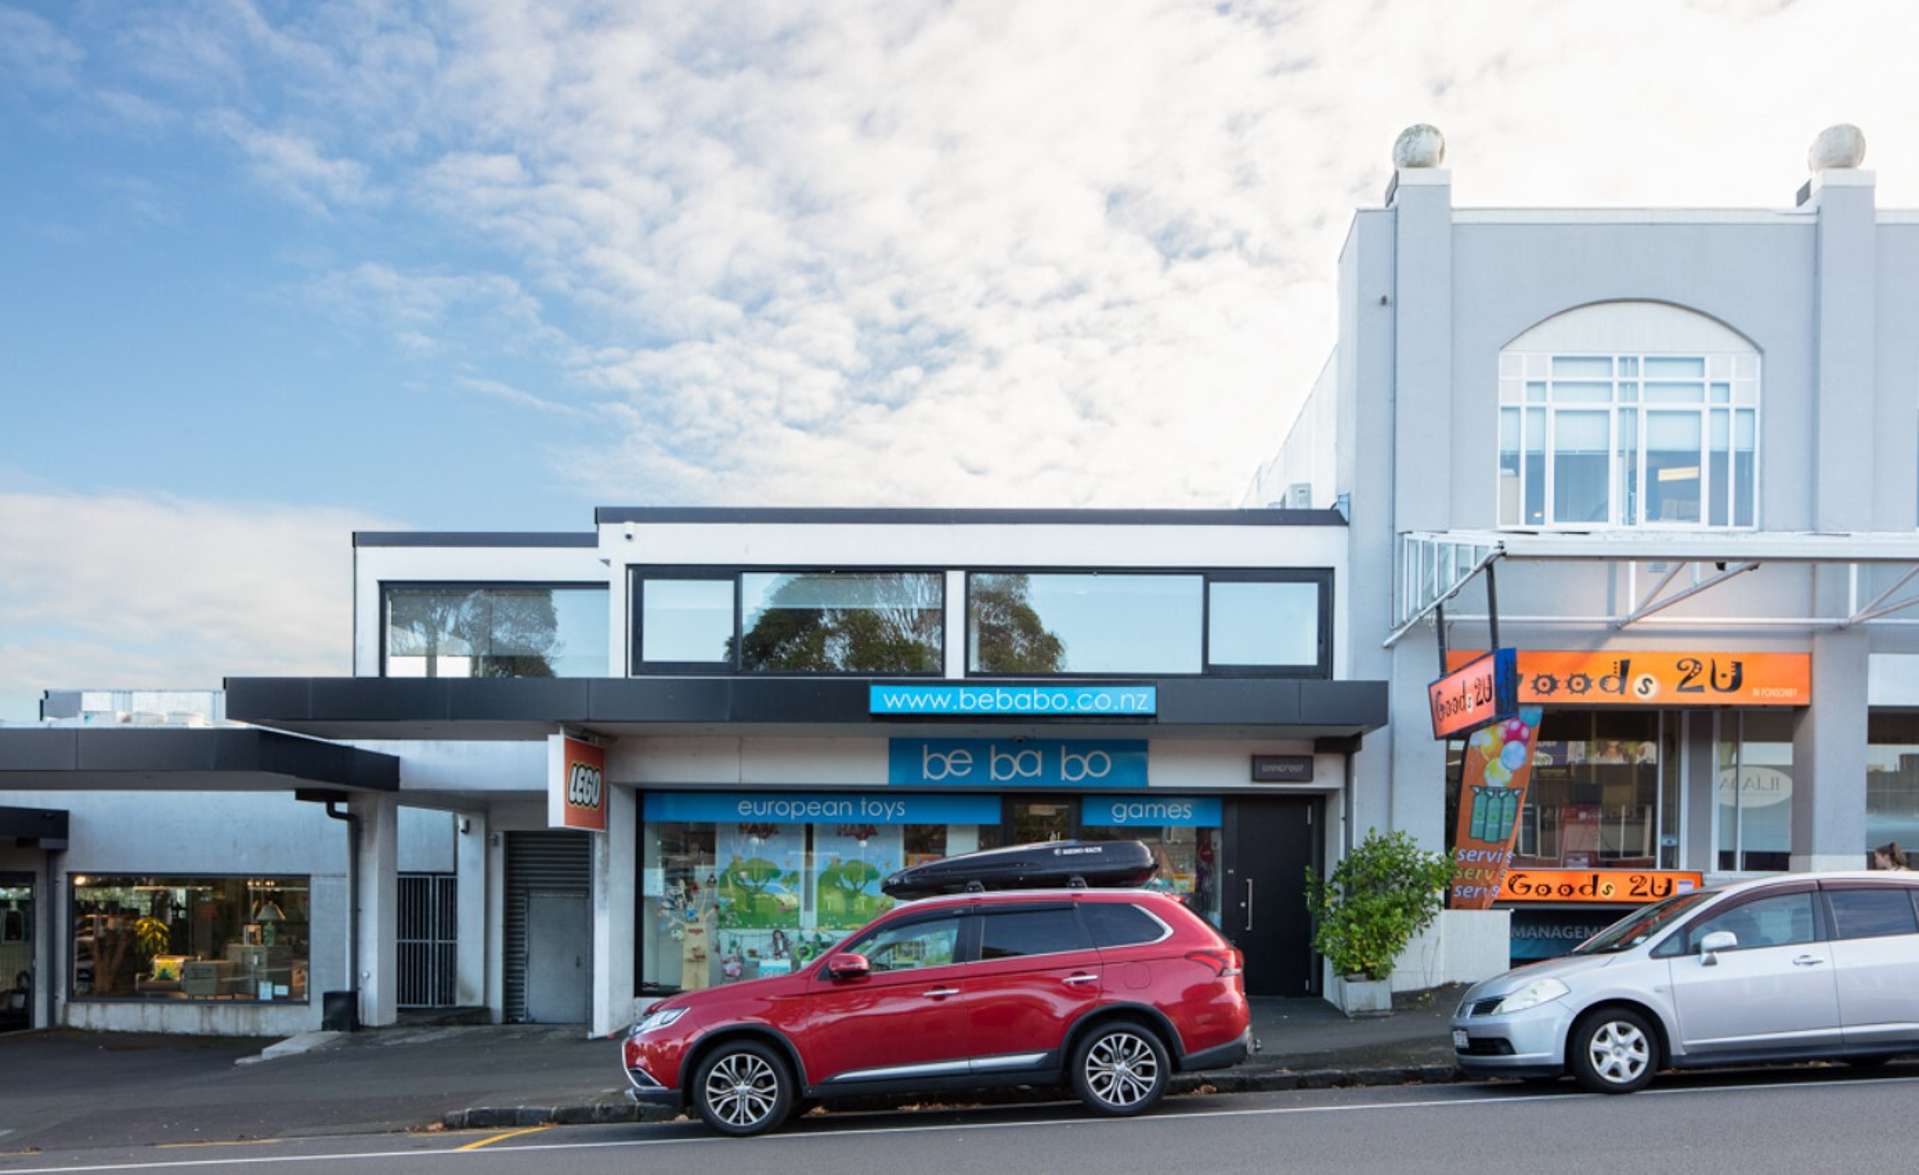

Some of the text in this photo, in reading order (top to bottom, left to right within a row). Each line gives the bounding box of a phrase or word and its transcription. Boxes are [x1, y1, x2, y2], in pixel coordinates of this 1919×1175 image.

[1474, 674, 1493, 706] 2U
[1517, 658, 1743, 696] oods 2U
[884, 688, 1149, 711] www.bebabo.co.nz
[922, 744, 1112, 781] be ba bo
[568, 764, 600, 807] LEGO
[737, 796, 906, 821] european toys
[1111, 802, 1193, 823] games
[1508, 874, 1673, 897] Goods 2U
